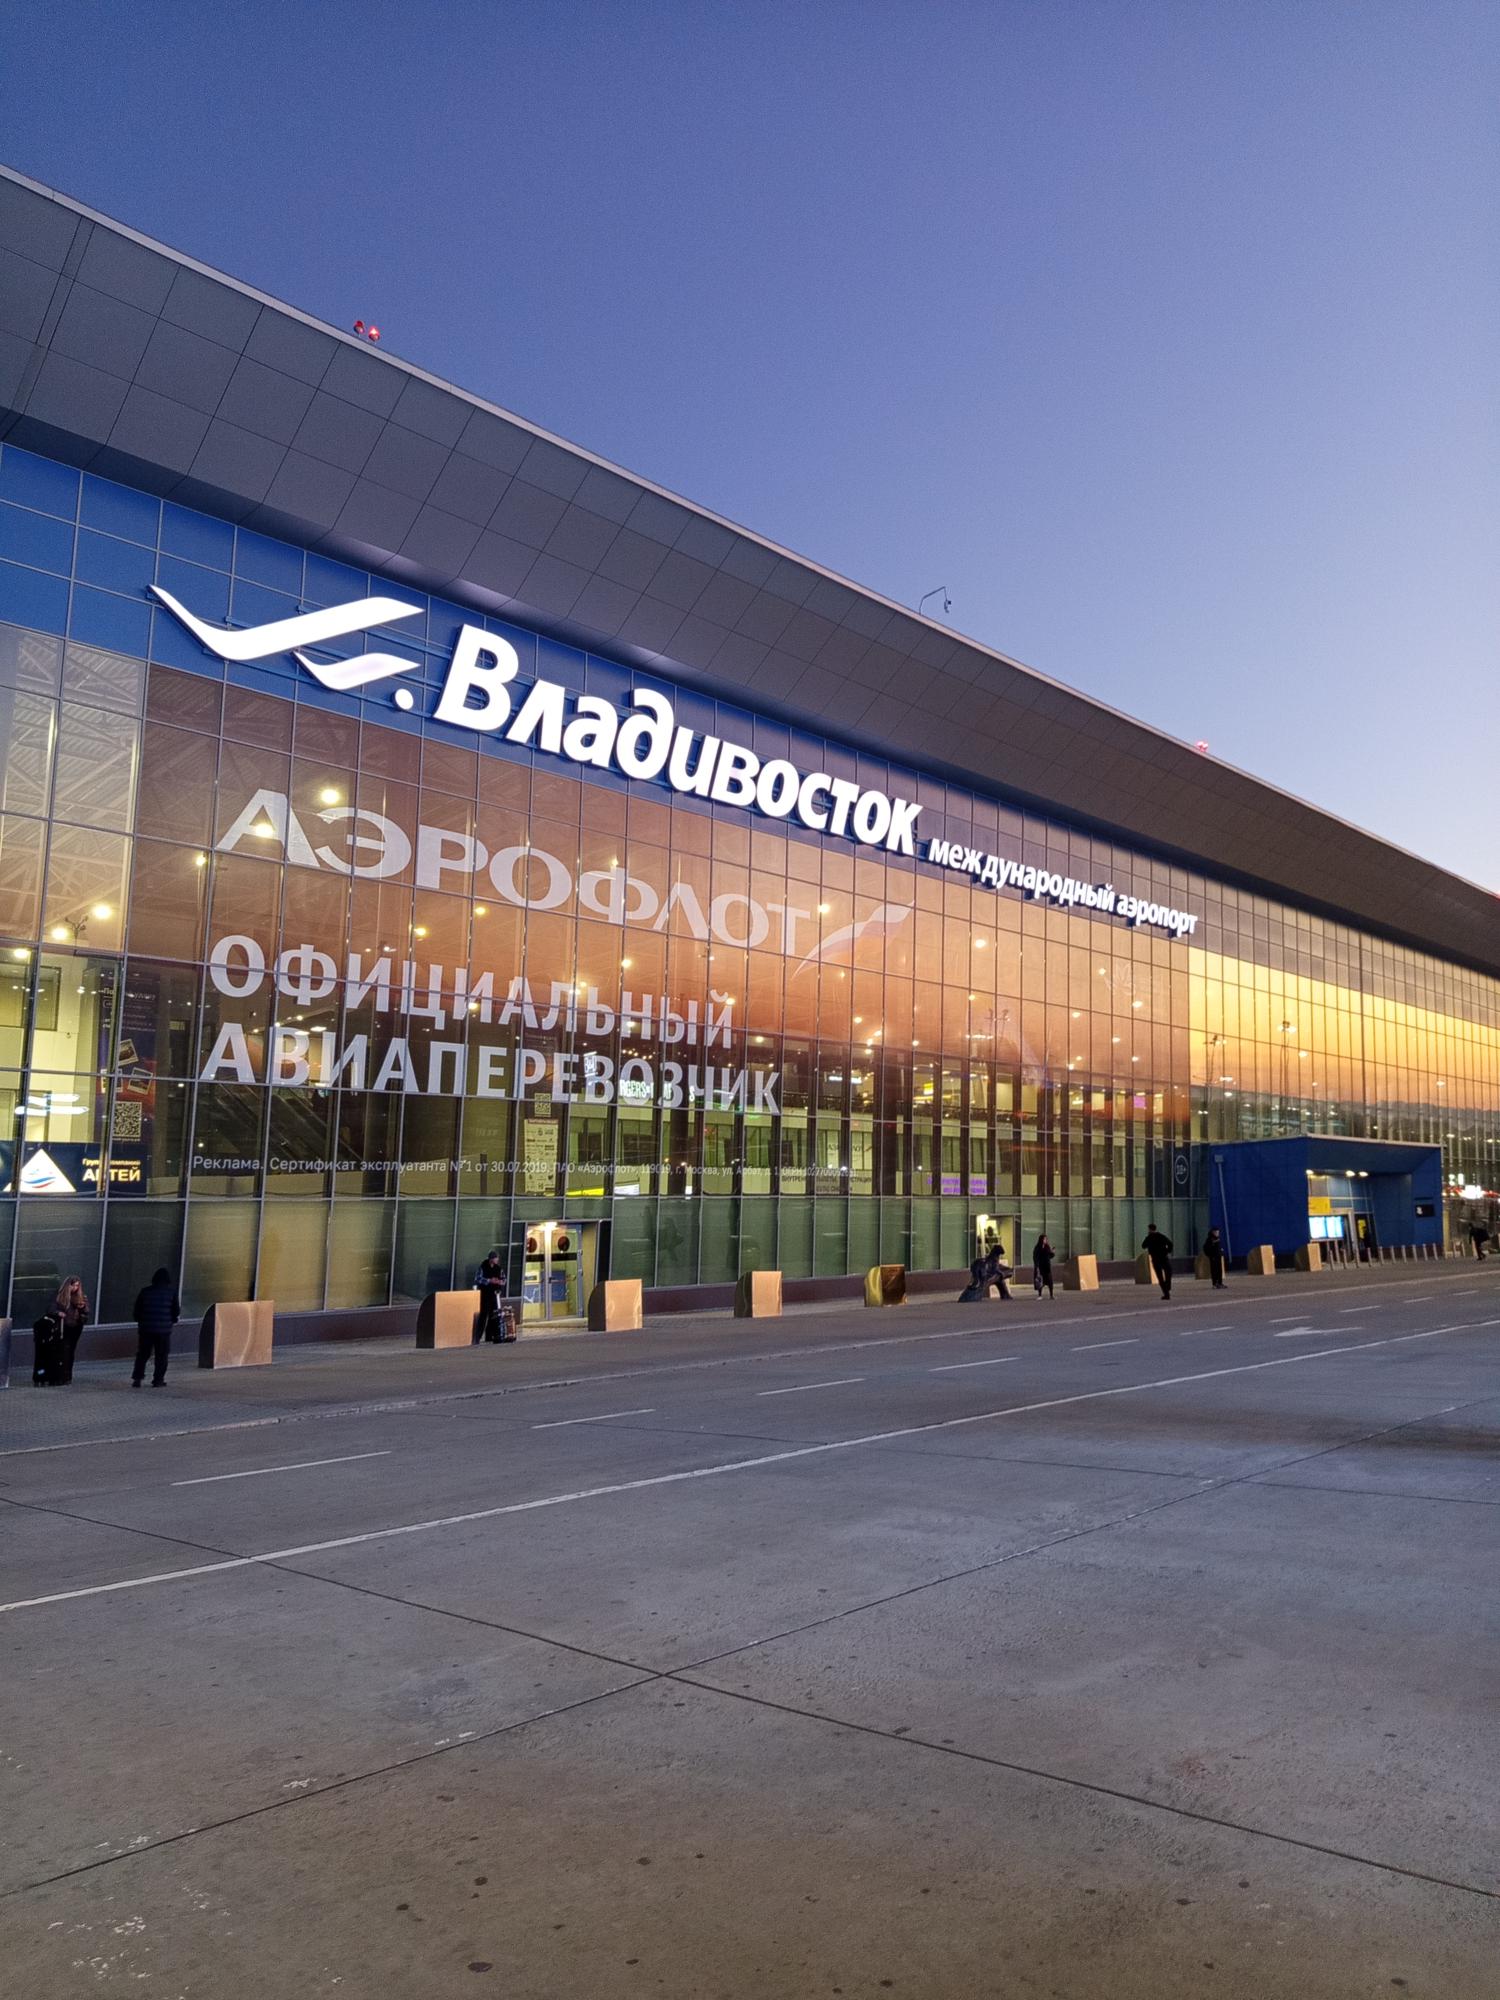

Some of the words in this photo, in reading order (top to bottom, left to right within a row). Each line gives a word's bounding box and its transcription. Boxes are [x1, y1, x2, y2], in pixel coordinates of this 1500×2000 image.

[433, 623, 923, 856] Владивосток
[928, 838, 1115, 912] международный
[1117, 893, 1198, 937] аэропорт
[214, 788, 814, 955] АЭРОФЛОТ
[209, 934, 733, 1048] ОФИЦИАЛЬНЫЙ
[200, 1022, 781, 1114] АВИАПЕРЕВОЗЧИК
[193, 1155, 264, 1170] Реклама.
[269, 1156, 356, 1173] Сертификат
[360, 1160, 446, 1176] эксплуатанта
[475, 1161, 488, 1173] от
